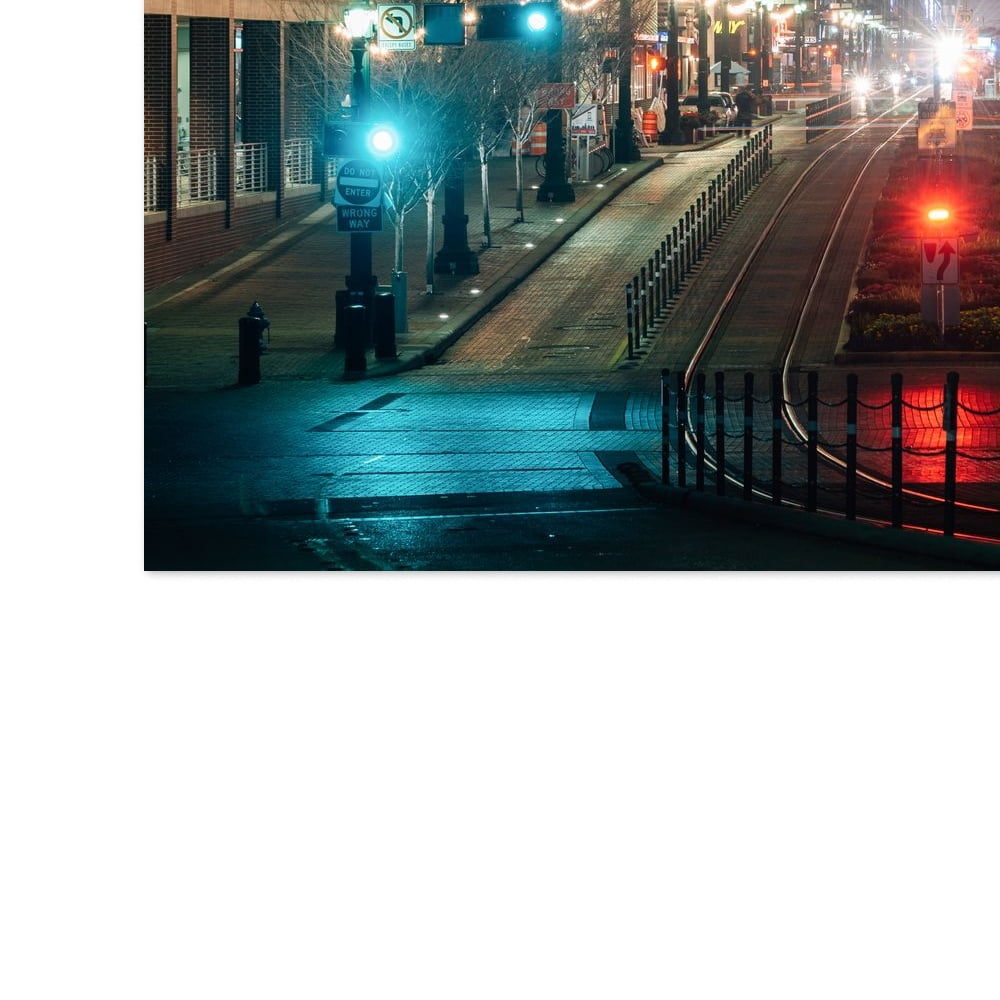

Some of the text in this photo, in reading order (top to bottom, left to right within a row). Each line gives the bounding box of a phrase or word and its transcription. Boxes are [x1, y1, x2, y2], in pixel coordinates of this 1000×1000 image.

[344, 167, 376, 177] DO NOT
[345, 187, 371, 197] ENTER
[342, 208, 378, 218] WRONG
[349, 218, 370, 229] WAY
